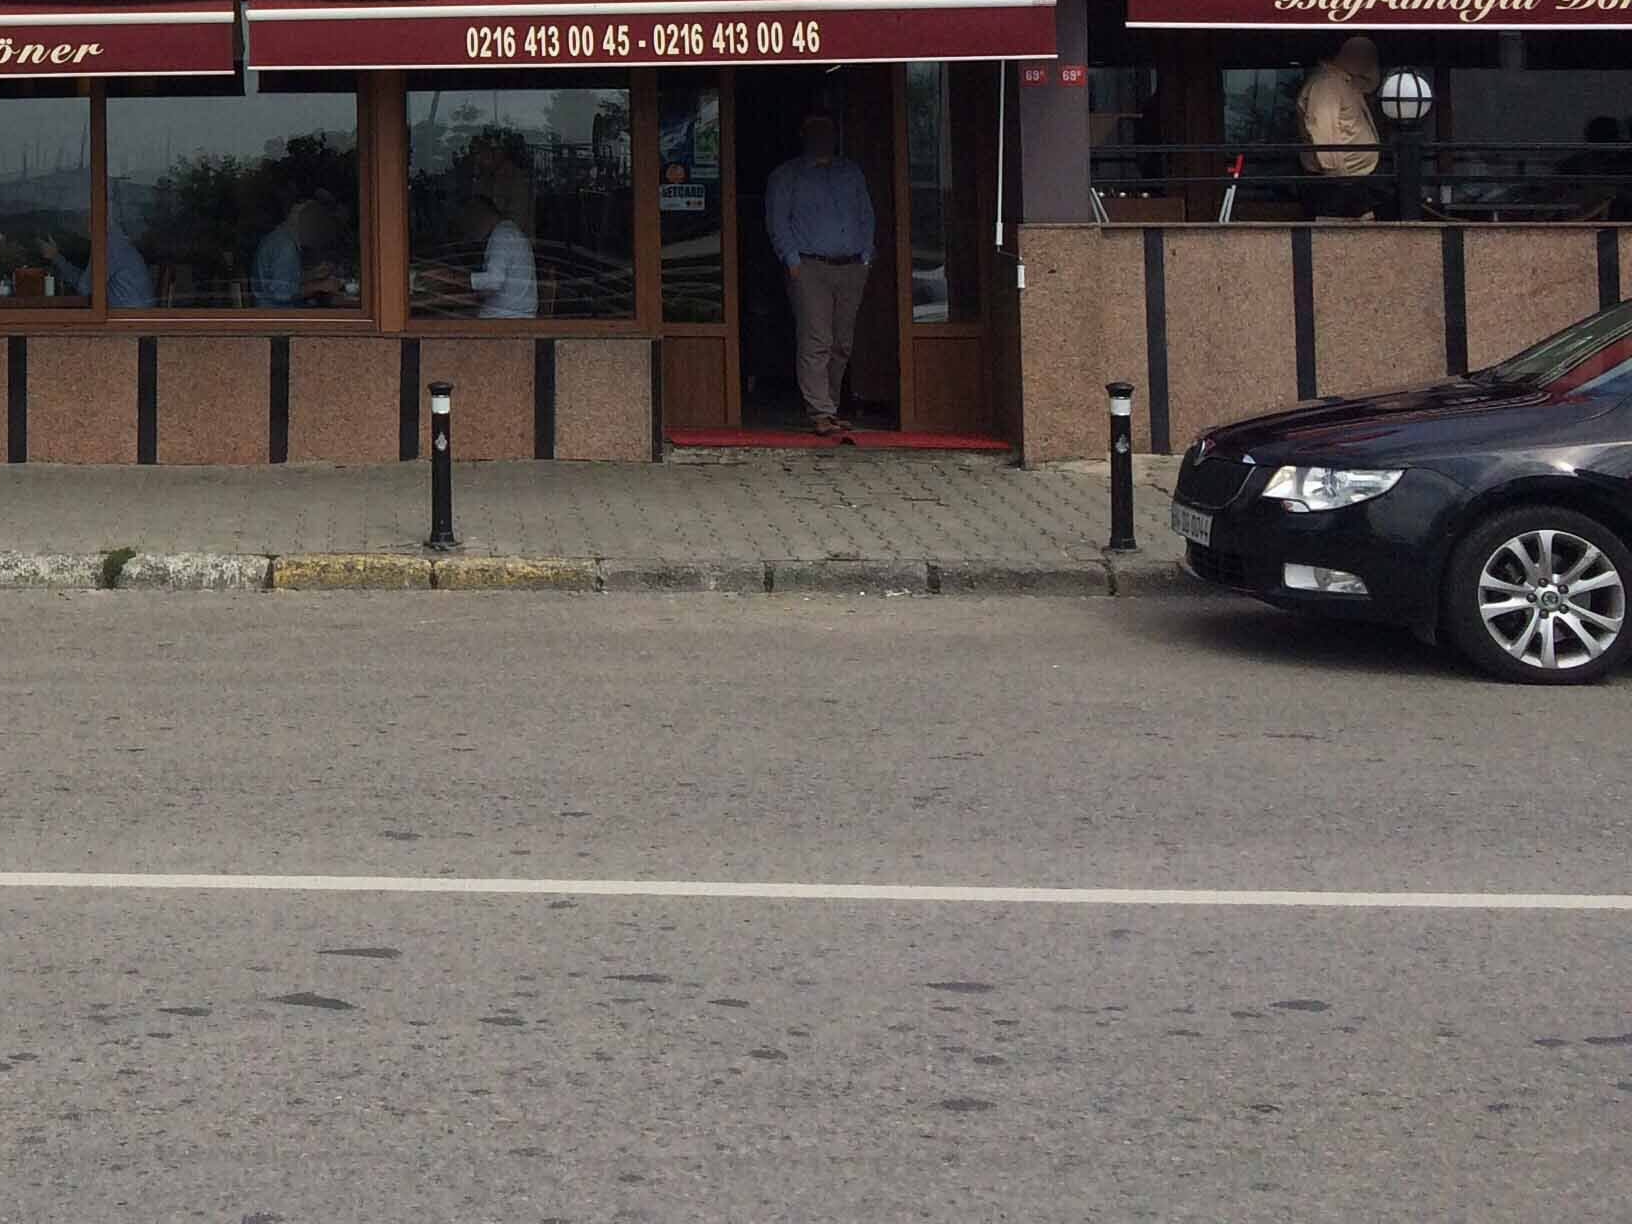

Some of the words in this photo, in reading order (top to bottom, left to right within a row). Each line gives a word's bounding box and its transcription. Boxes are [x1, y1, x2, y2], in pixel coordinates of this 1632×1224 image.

[466, 26, 517, 58] 0216
[524, 26, 561, 57] 413
[568, 25, 595, 57] 00
[602, 25, 631, 57] 45
[653, 23, 705, 56] 0216
[712, 22, 750, 55] 413
[756, 22, 784, 54] 00
[792, 21, 820, 53] 46
